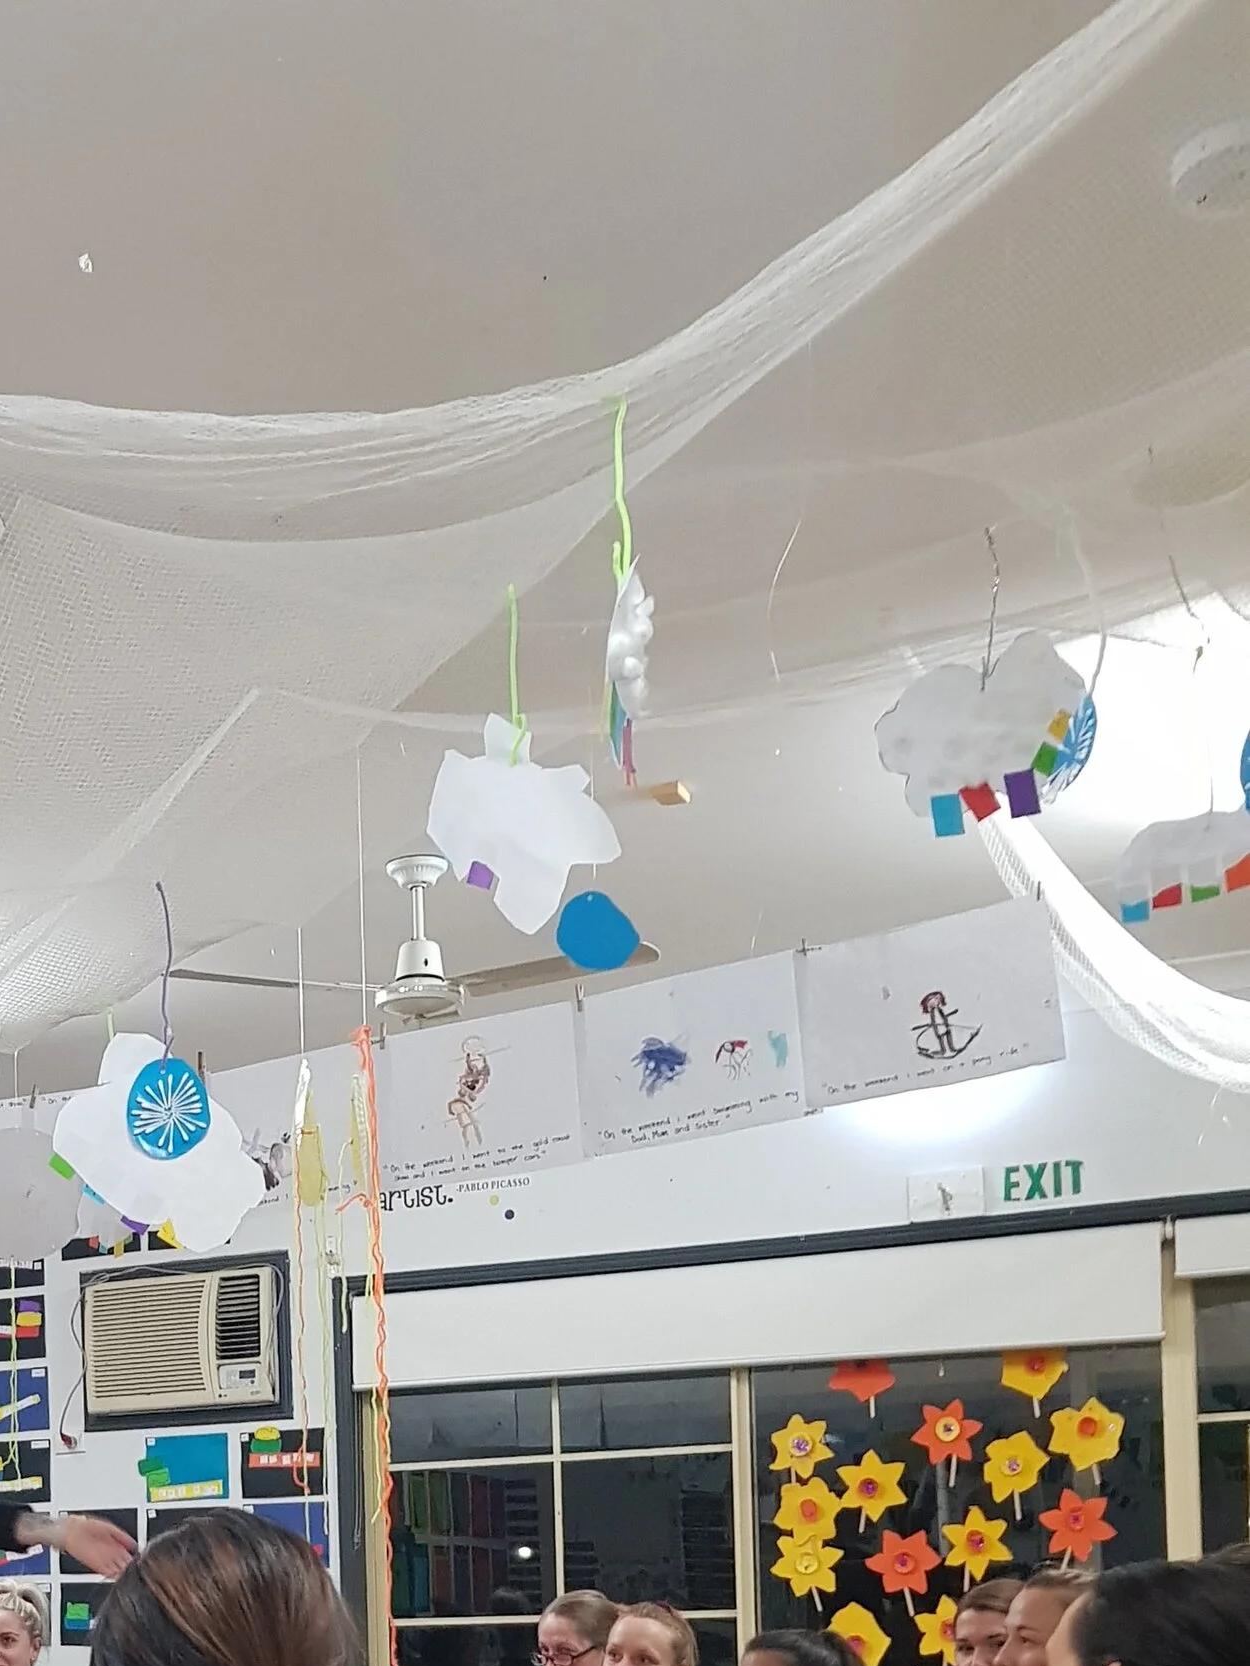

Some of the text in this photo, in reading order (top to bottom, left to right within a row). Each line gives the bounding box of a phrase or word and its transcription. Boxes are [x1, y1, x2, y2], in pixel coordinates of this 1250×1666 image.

[784, 1090, 800, 1104] my
[674, 1124, 690, 1135] and
[412, 1170, 426, 1180] and
[1003, 1159, 1084, 1202] EXIT
[491, 1176, 531, 1190] PICASSO
